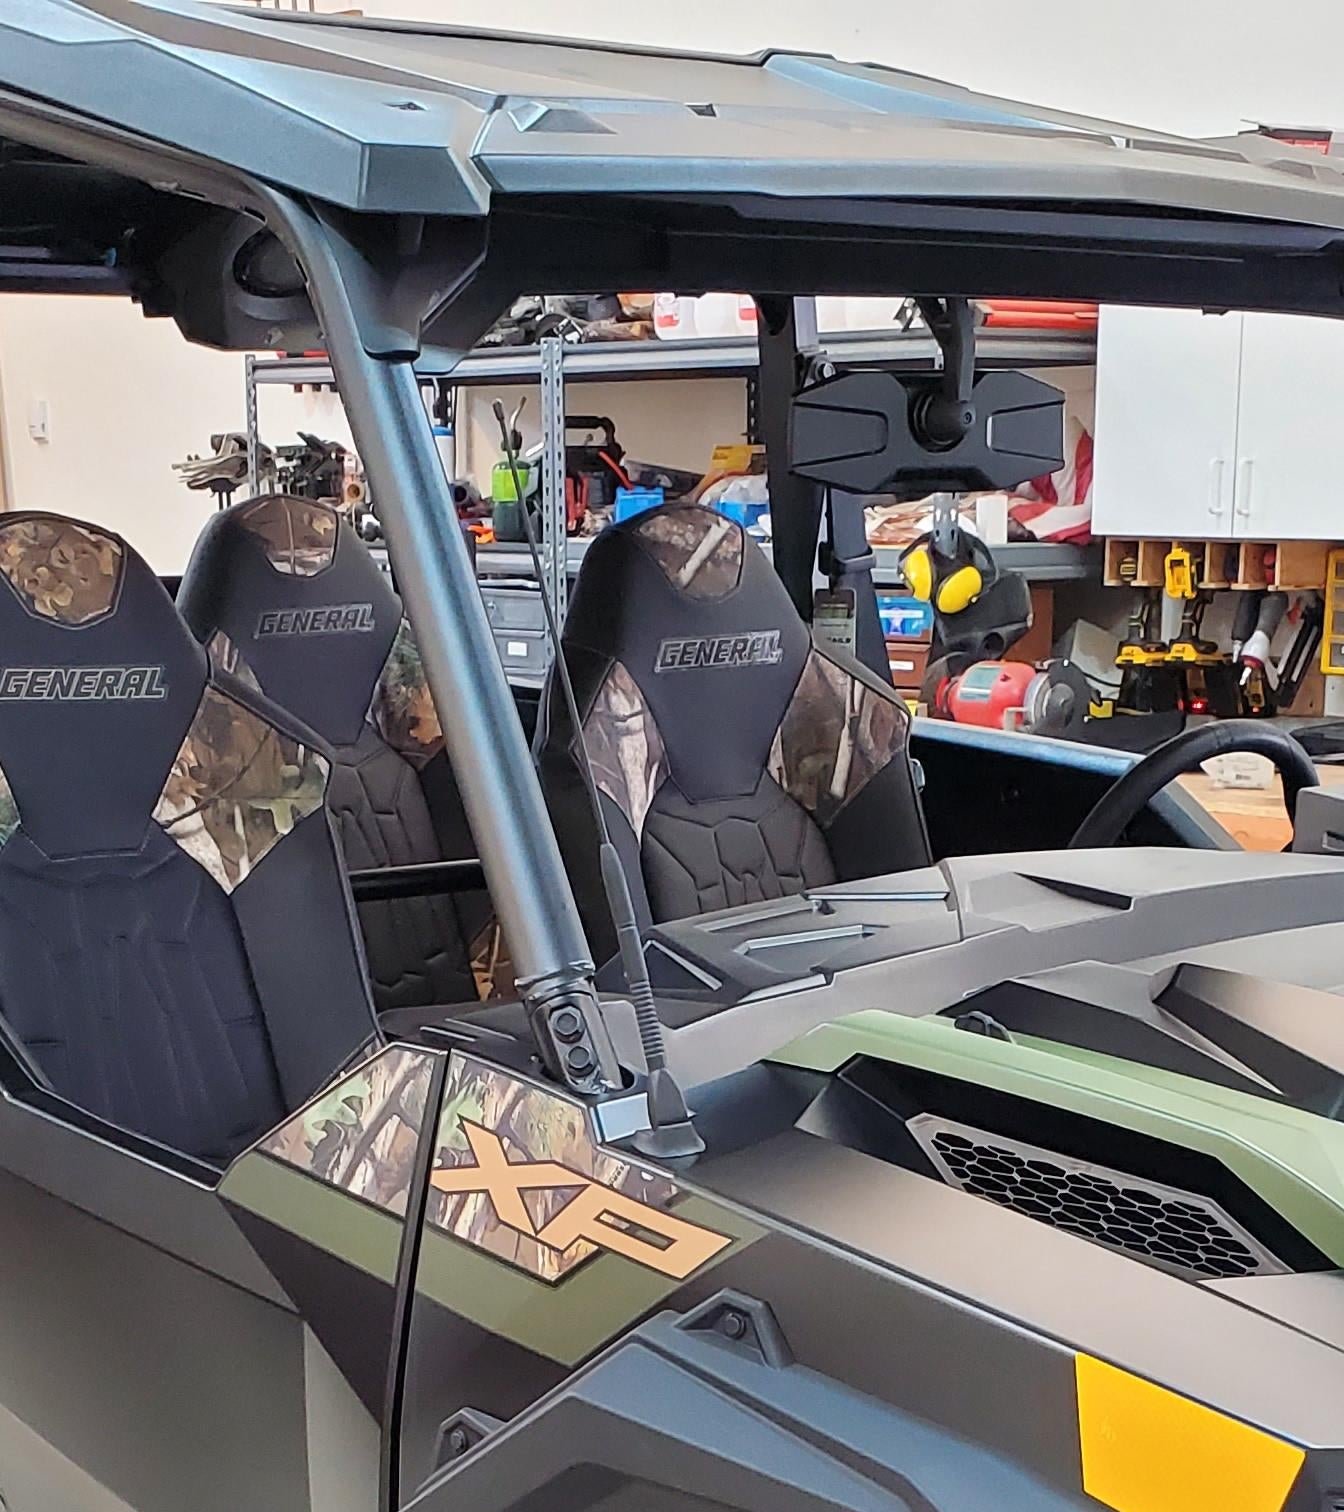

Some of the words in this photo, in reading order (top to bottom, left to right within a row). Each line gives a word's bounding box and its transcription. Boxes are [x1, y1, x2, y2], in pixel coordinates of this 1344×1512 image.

[253, 603, 375, 639] GENERAL
[654, 629, 783, 673] GENERAL
[430, 1113, 734, 1280] XP
